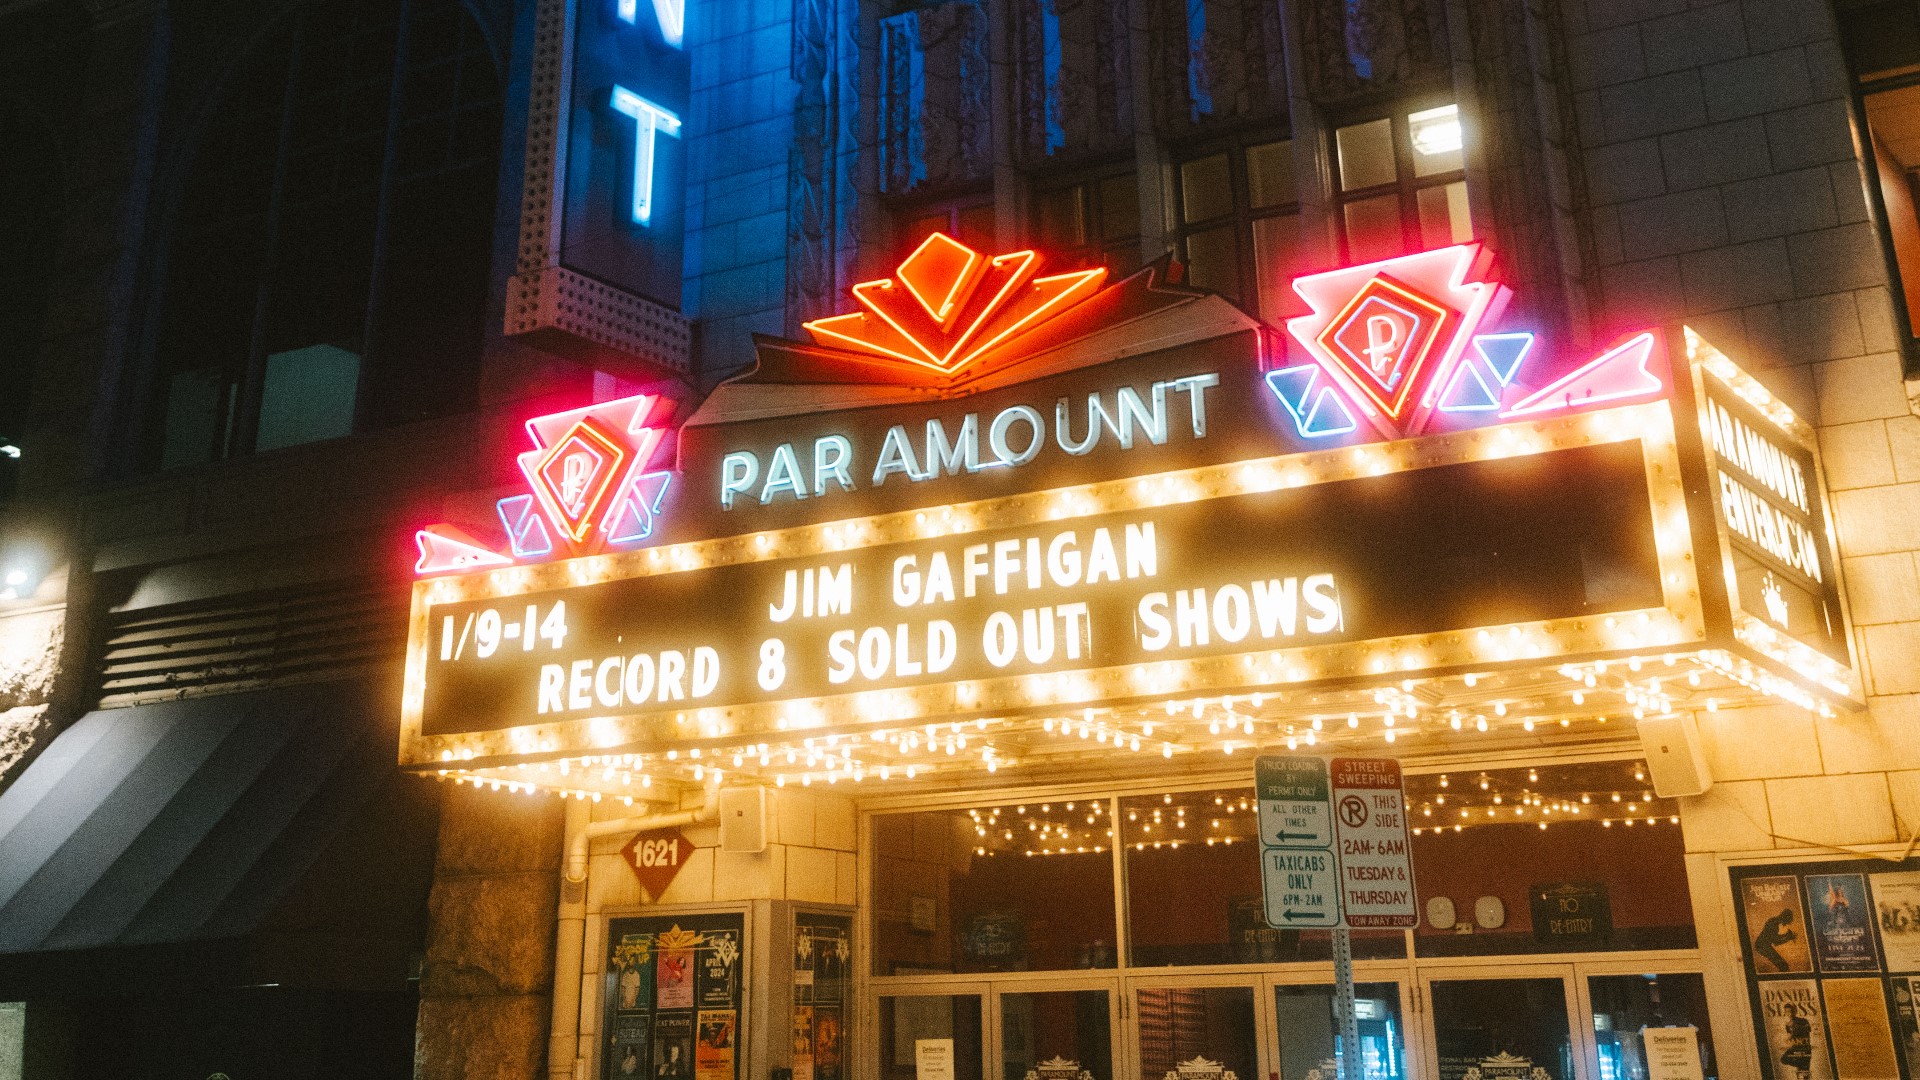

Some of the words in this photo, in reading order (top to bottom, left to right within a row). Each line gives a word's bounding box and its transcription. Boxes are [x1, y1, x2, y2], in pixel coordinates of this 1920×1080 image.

[721, 372, 1219, 511] PARAMOUNT
[769, 563, 853, 622] JIM
[892, 521, 1157, 607] GAFFIGAN
[441, 600, 568, 661] 1/9-14
[537, 646, 720, 714] RECORD
[757, 638, 786, 691] 8
[828, 620, 957, 684] SOLD
[983, 602, 1088, 668] OUT
[1138, 573, 1341, 652] SHOWS
[1263, 760, 1286, 770] TRUCK
[1288, 761, 1319, 771] LOADING
[1344, 762, 1387, 773] STREET
[1286, 774, 1296, 783] BY
[1338, 774, 1395, 785] SWEEPING
[1268, 786, 1295, 796] PERMIT
[1297, 787, 1316, 796] ONLY
[1372, 795, 1397, 809] THIS
[1272, 805, 1287, 814] ALL
[1292, 805, 1317, 815] OTHER
[1284, 818, 1307, 828] TIMES
[1375, 814, 1400, 828] SIDE
[633, 838, 678, 868] 1621
[1274, 856, 1326, 872] TAXICABS
[1347, 866, 1395, 881] TUESDAY
[1397, 867, 1406, 881] &
[1288, 874, 1313, 890] ONLY
[1349, 890, 1408, 905] THURSDAY
[1559, 897, 1579, 913] NO
[1350, 916, 1366, 926] TOW
[1367, 916, 1392, 926] AWAY
[1393, 916, 1414, 926] ZONE
[1550, 918, 1593, 934] RE-ENTRY
[710, 969, 725, 978] 2024
[1765, 988, 1815, 1003] DANIEL
[1765, 1002, 1818, 1017] SLSS
[1484, 1067, 1528, 1075] PARAMOUNT
